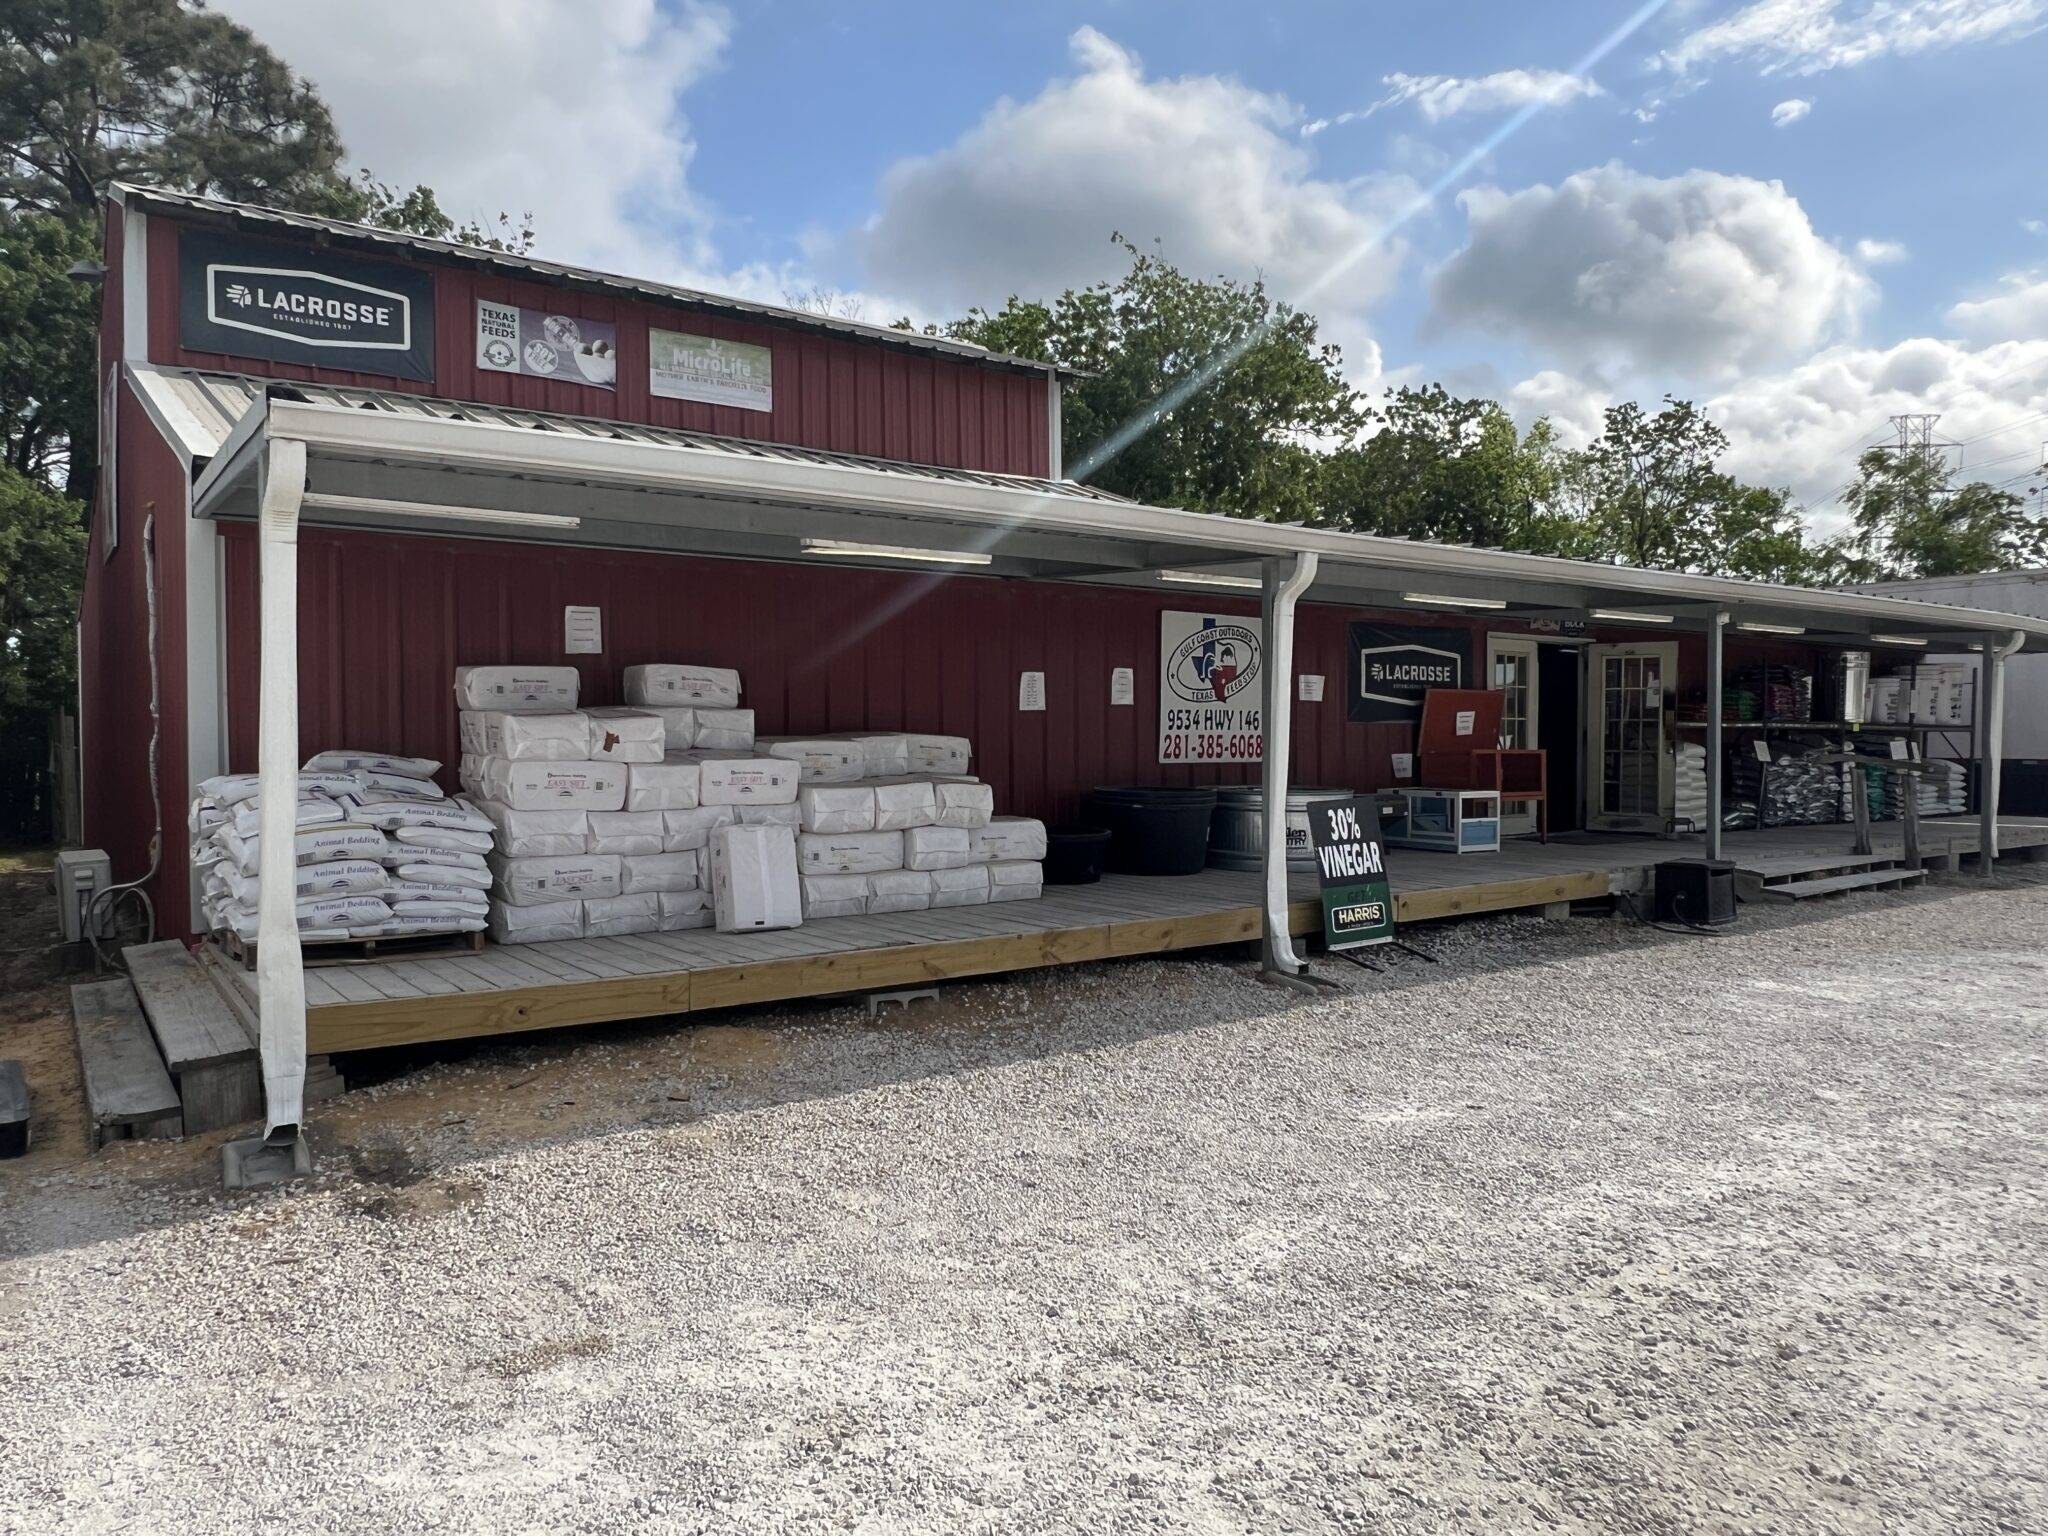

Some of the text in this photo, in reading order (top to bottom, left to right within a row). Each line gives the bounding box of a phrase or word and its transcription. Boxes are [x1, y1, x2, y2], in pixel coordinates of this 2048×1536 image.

[257, 288, 390, 327] LACROSSE
[481, 308, 516, 322] TEXAS
[481, 319, 515, 330] NATURAL
[481, 327, 516, 339] FEEDS
[673, 347, 751, 377] MicroLife
[1180, 627, 1253, 657] GULF COAST OUTDOORS
[1386, 664, 1451, 682] LACROSSE
[1191, 691, 1214, 700] TEXAS
[1167, 709, 1260, 731] 9534 HWY 146
[1163, 734, 1263, 759] 281-385-6068
[405, 808, 435, 816] Animal
[1327, 807, 1361, 840] 30%
[314, 836, 380, 848] Animal Bedding
[1318, 842, 1384, 879] VINEGAR
[313, 865, 380, 877] Animal Bedding
[313, 902, 345, 912] Animal
[1338, 906, 1380, 924] HARRIS
